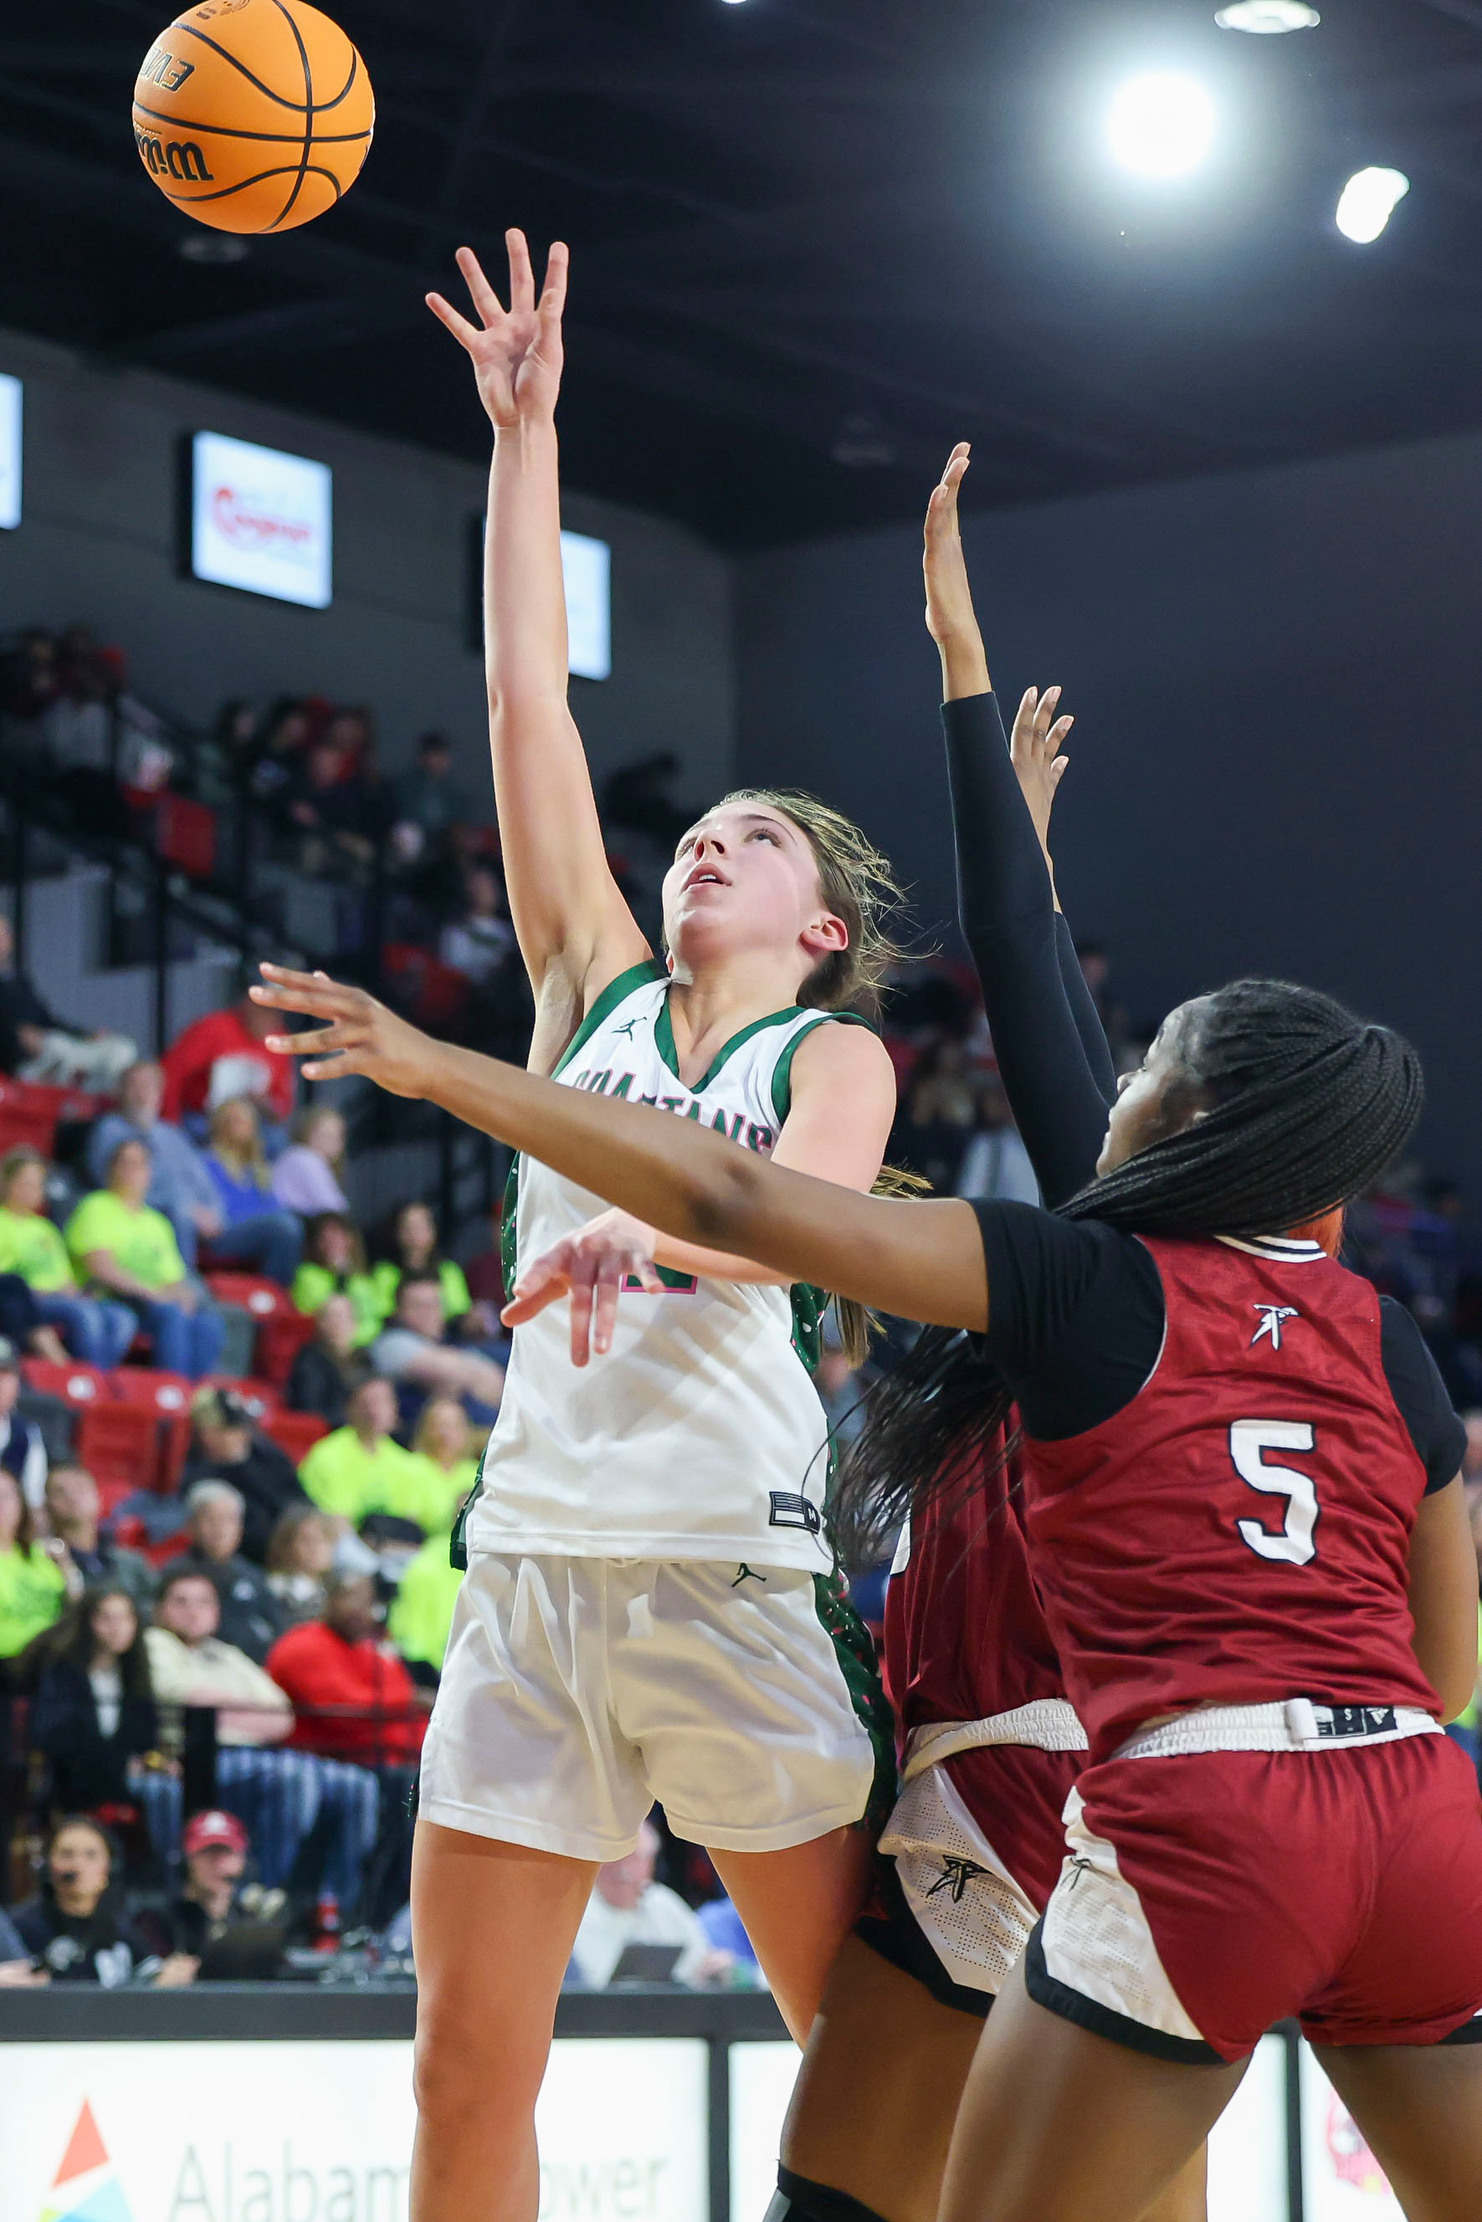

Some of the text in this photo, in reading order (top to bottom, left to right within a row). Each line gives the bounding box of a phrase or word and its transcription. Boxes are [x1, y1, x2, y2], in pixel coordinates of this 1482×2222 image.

[1229, 1419, 1320, 1566] 5
[167, 2138, 669, 2222] Alabam wer
